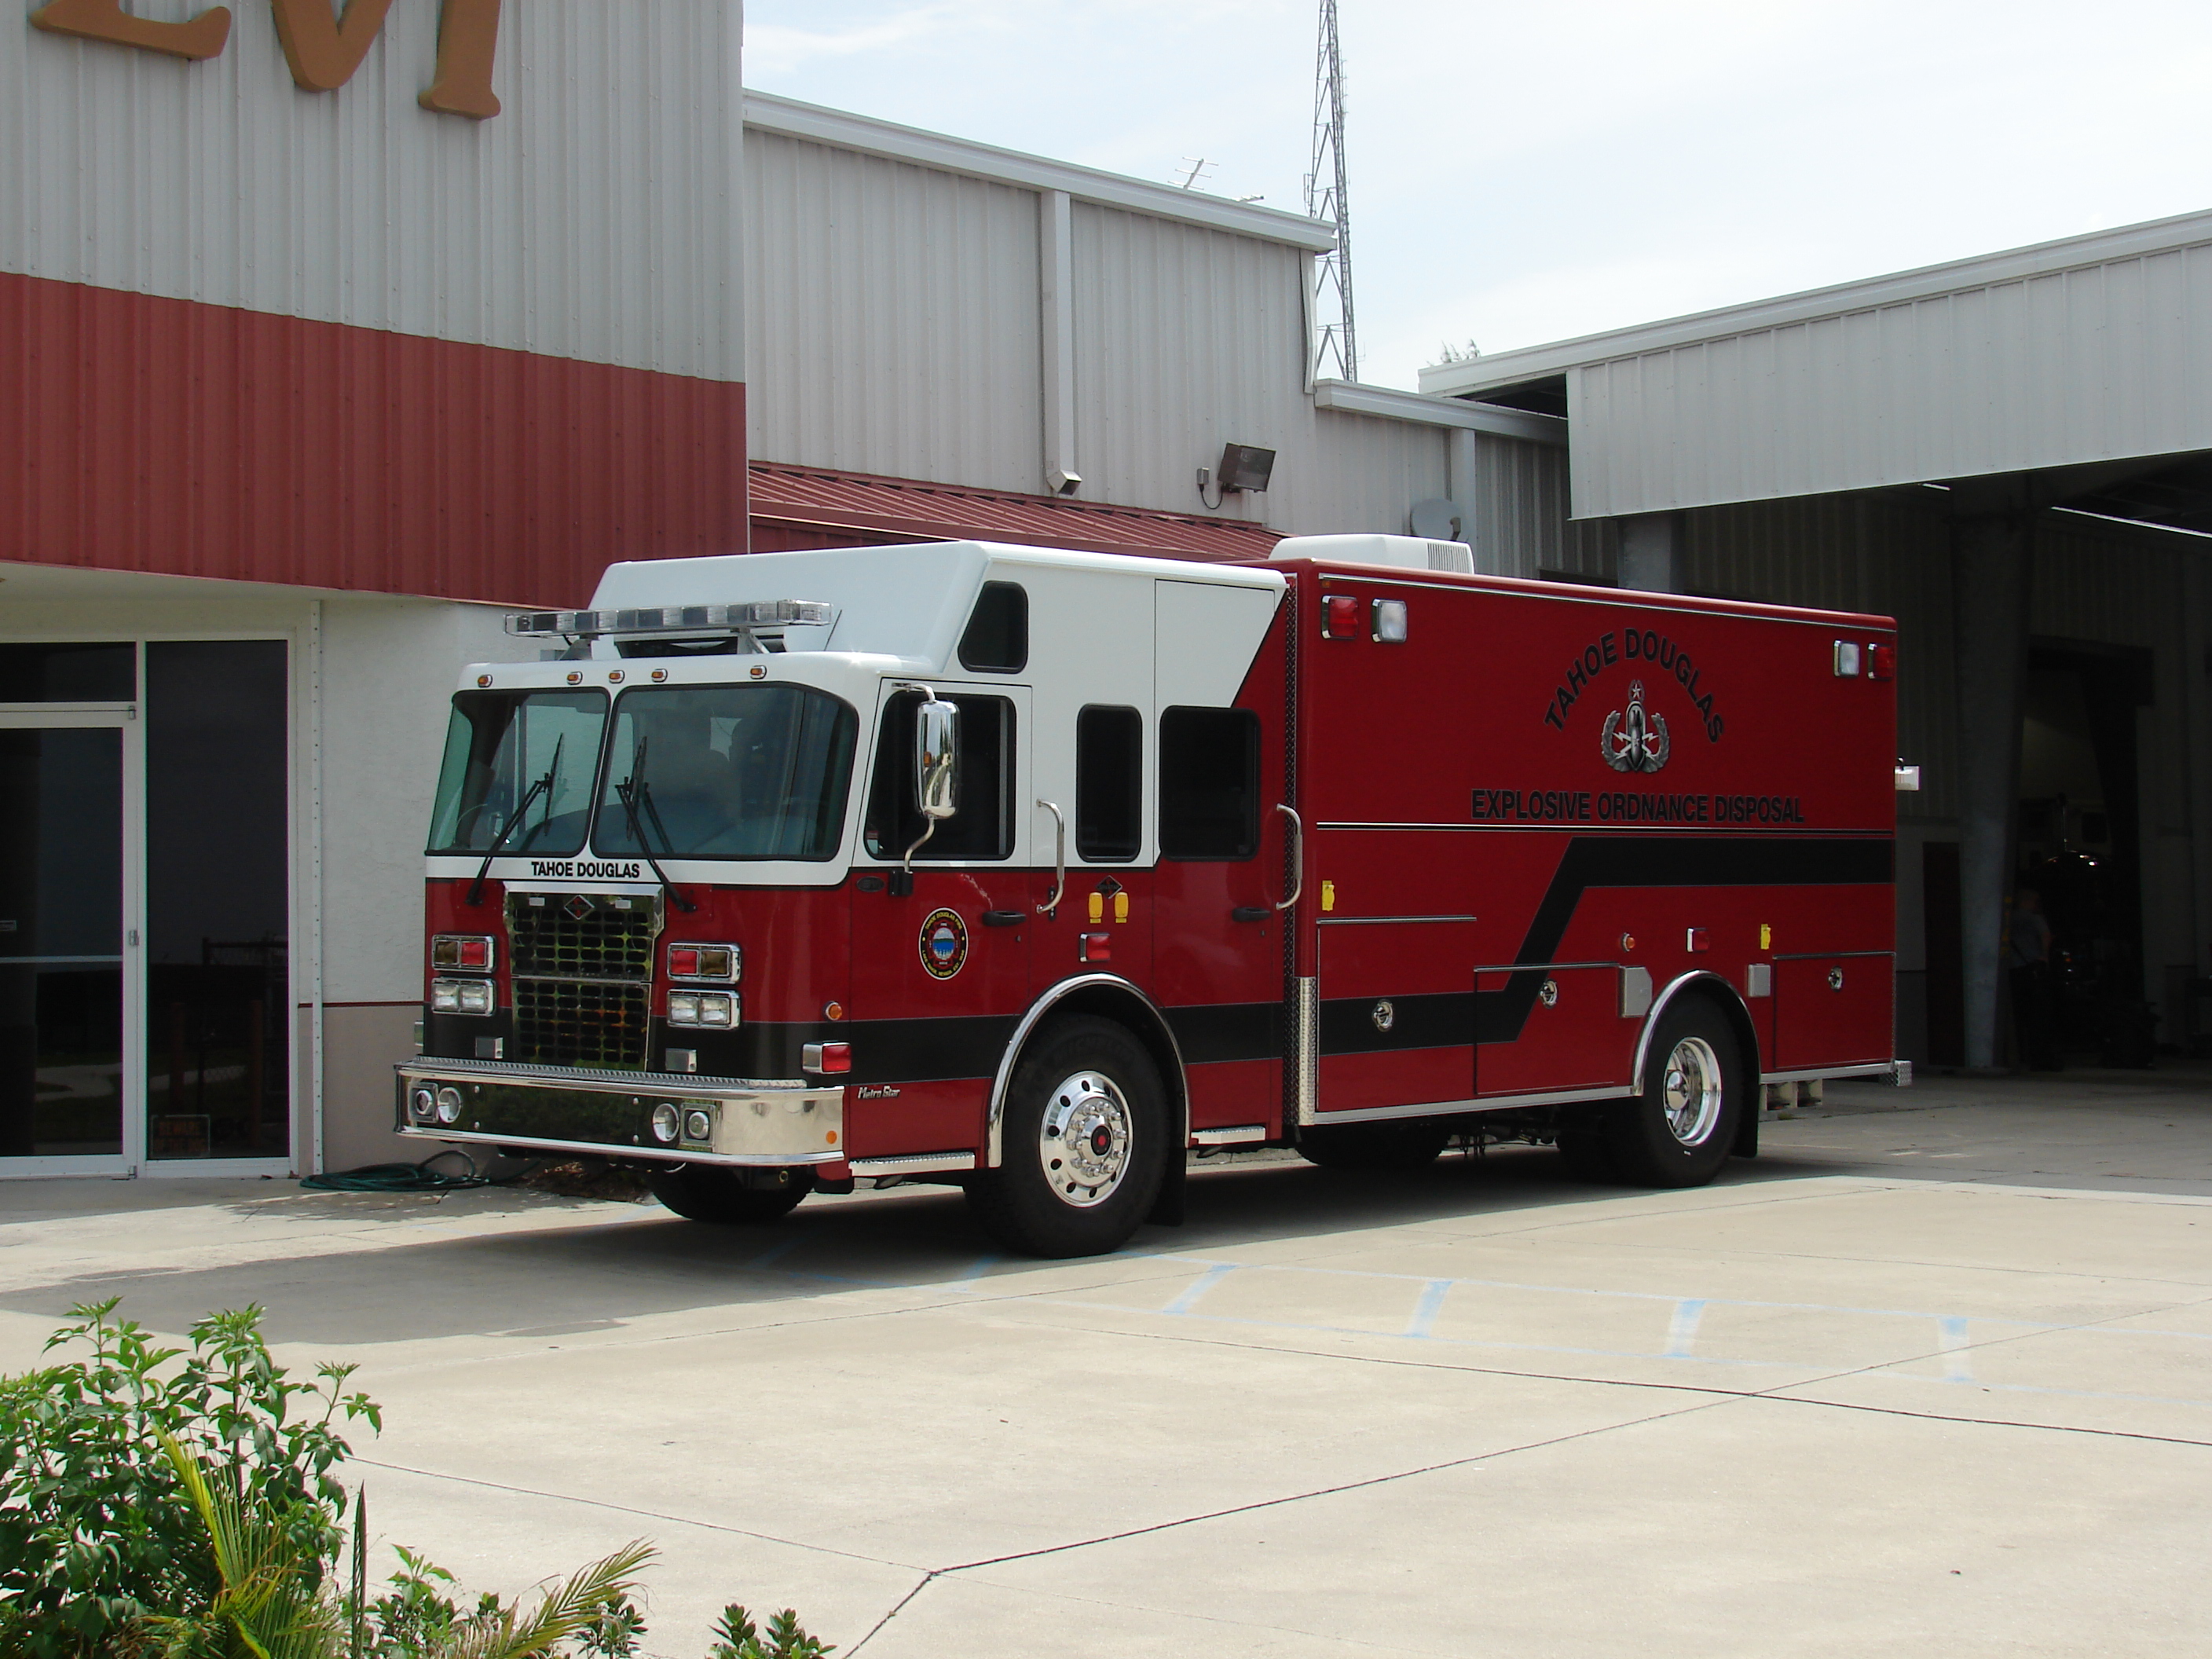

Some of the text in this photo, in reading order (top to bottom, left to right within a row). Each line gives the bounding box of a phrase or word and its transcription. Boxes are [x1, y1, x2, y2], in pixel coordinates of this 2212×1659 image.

[1544, 628, 1725, 743] TAHOE DOUGLAS
[1471, 788, 1804, 824] EXPLOSIVE ORDNANCE DISPOSAL
[531, 861, 640, 878] TAHOE DOUGLAS
[857, 1085, 901, 1099] Metro Star
